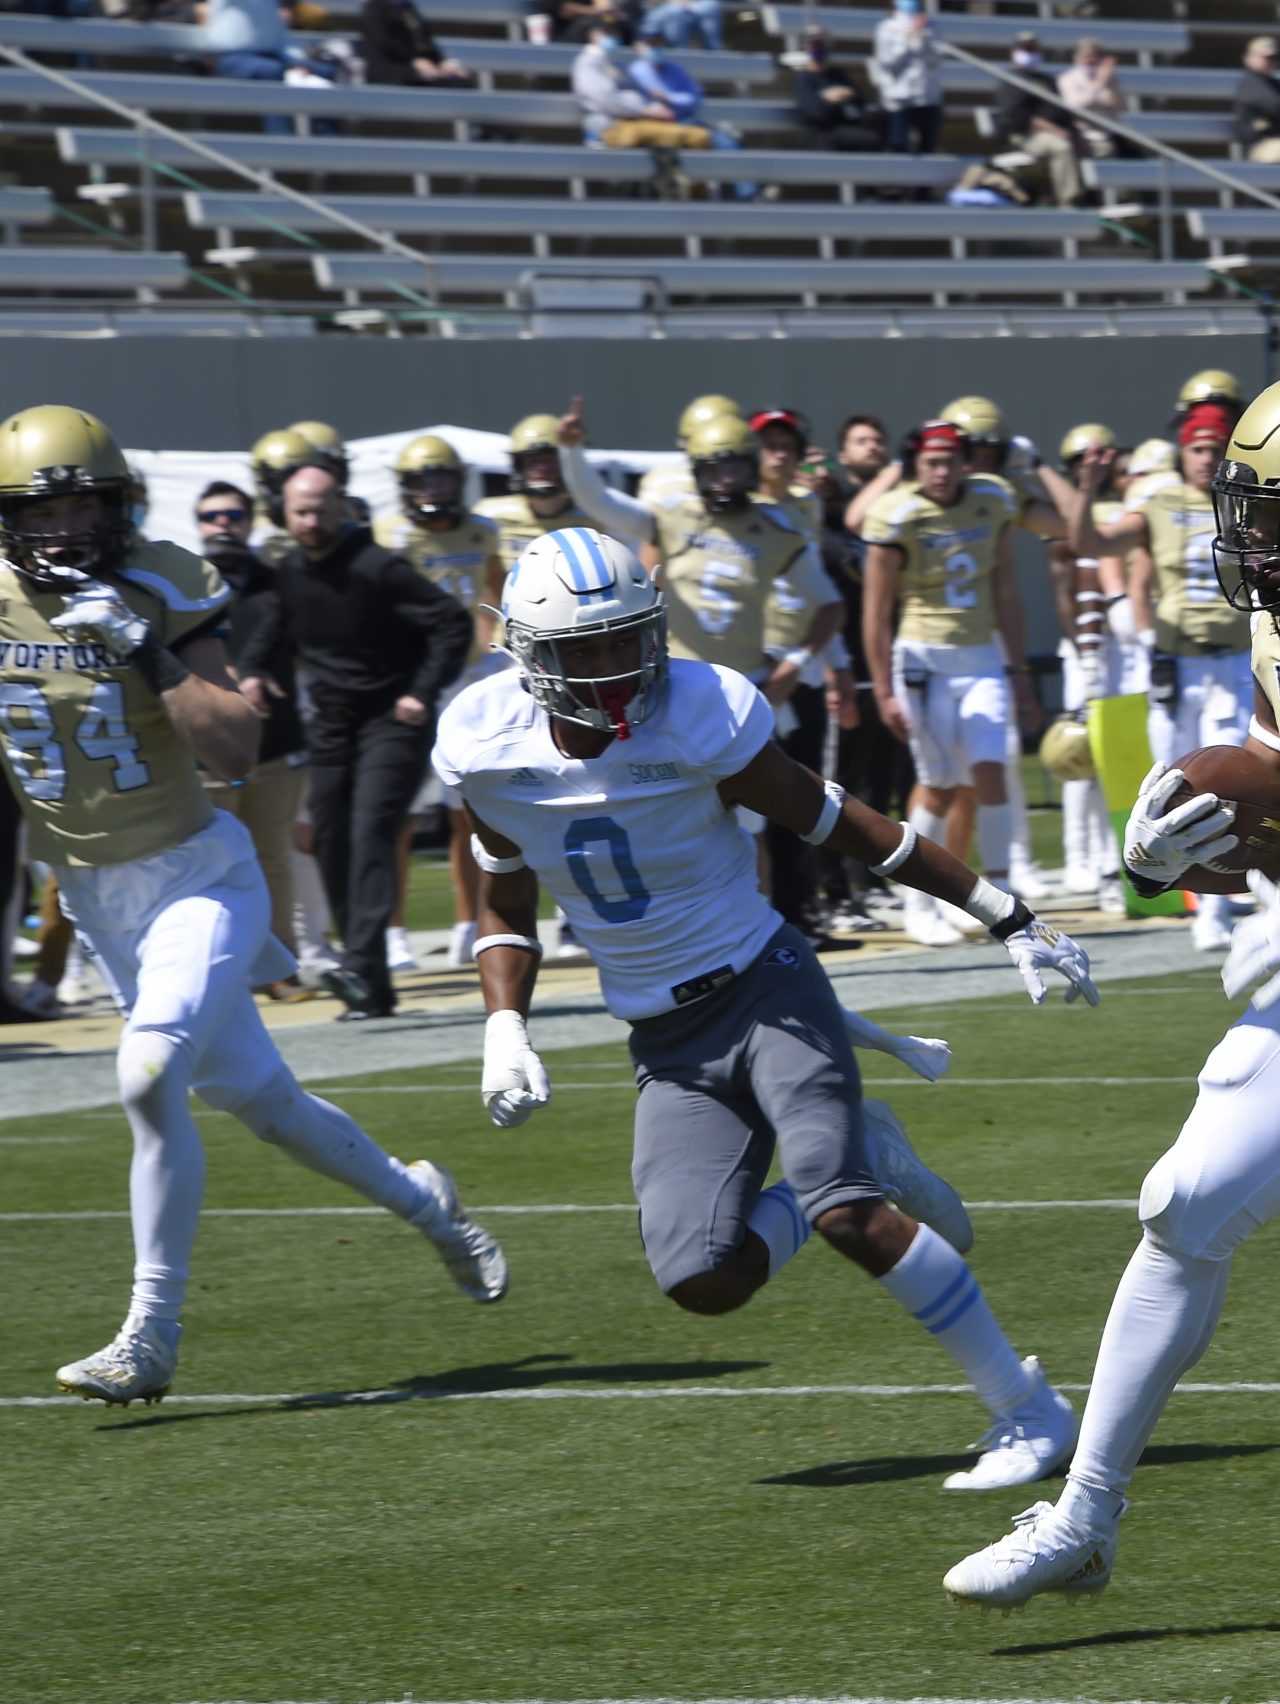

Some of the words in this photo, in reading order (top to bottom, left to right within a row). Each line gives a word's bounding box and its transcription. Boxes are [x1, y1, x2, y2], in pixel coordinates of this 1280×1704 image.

[945, 553, 977, 608] 2
[0, 682, 150, 800] 84
[563, 816, 651, 924] 0
